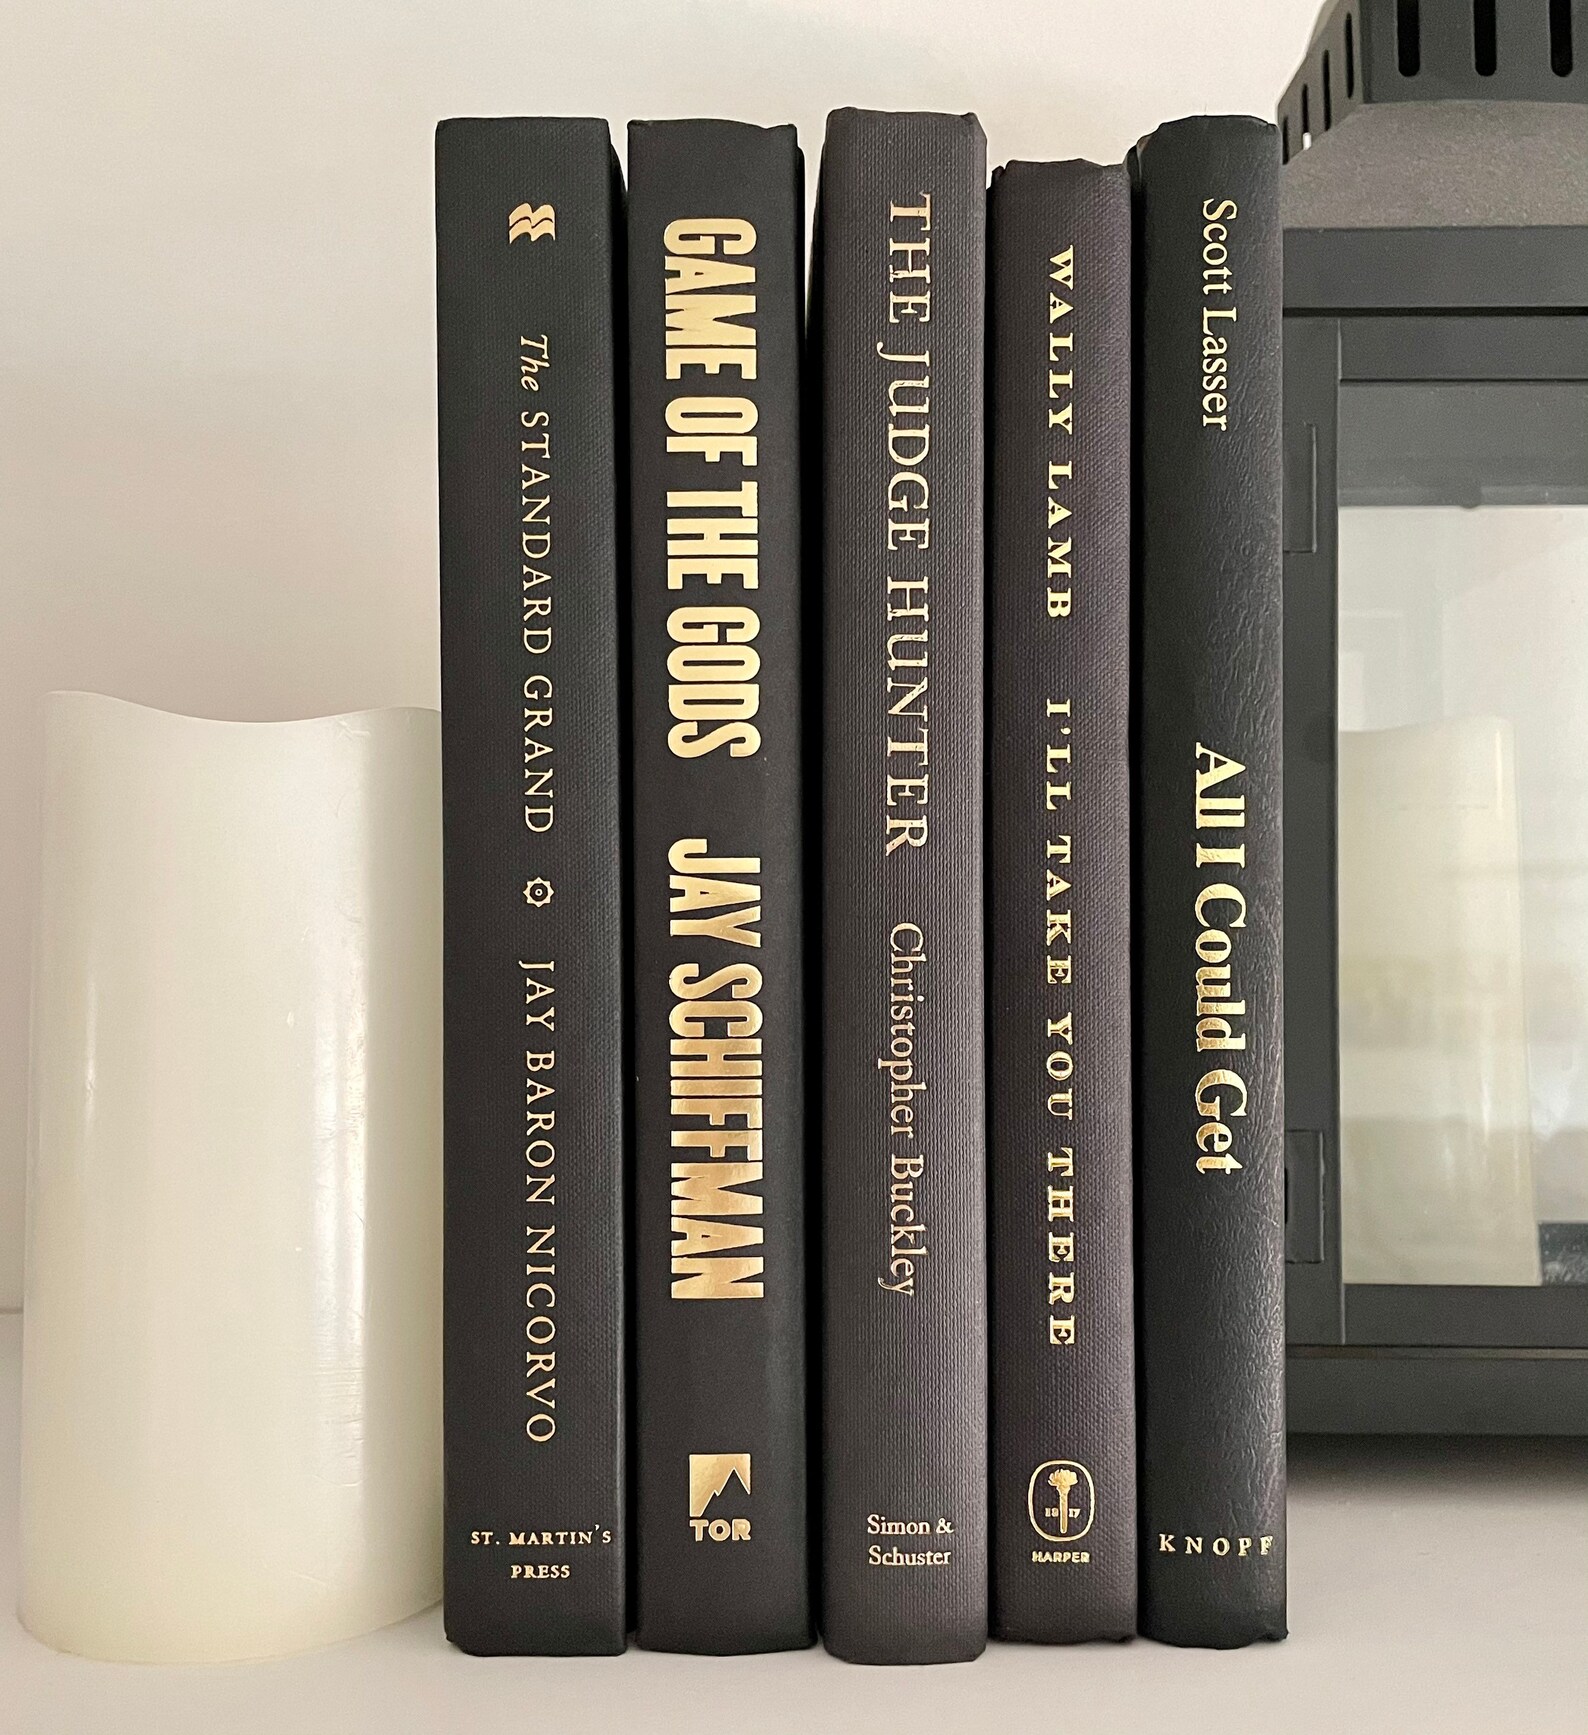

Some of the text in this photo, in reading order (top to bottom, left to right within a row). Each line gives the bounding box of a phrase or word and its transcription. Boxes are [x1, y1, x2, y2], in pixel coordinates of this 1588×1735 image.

[663, 218, 761, 759] GAME OF THE GODS
[1046, 244, 1074, 618] WALLY LAMB
[1202, 198, 1238, 431] Scott Lasser
[520, 335, 554, 833] The STANDARD GRAND
[876, 190, 931, 857] THE JUDGE HUNTER
[667, 838, 764, 1299] JAY SCHIFFMAN
[877, 922, 928, 1298] Christopher Buckley
[1045, 698, 1075, 1345] I'LL TAKE YOU THERE
[1194, 741, 1248, 1175] All I Could Get
[518, 960, 556, 1442] JAY BARON NICORVO
[470, 1524, 612, 1546] ST. MARTIN'S
[510, 1564, 570, 1579] PRESS
[689, 1518, 752, 1542] TOR
[867, 1513, 955, 1535] Simon &
[868, 1544, 952, 1566] Schuster
[1031, 1550, 1090, 1564] HARPER
[1159, 1533, 1274, 1557] KNOPF
